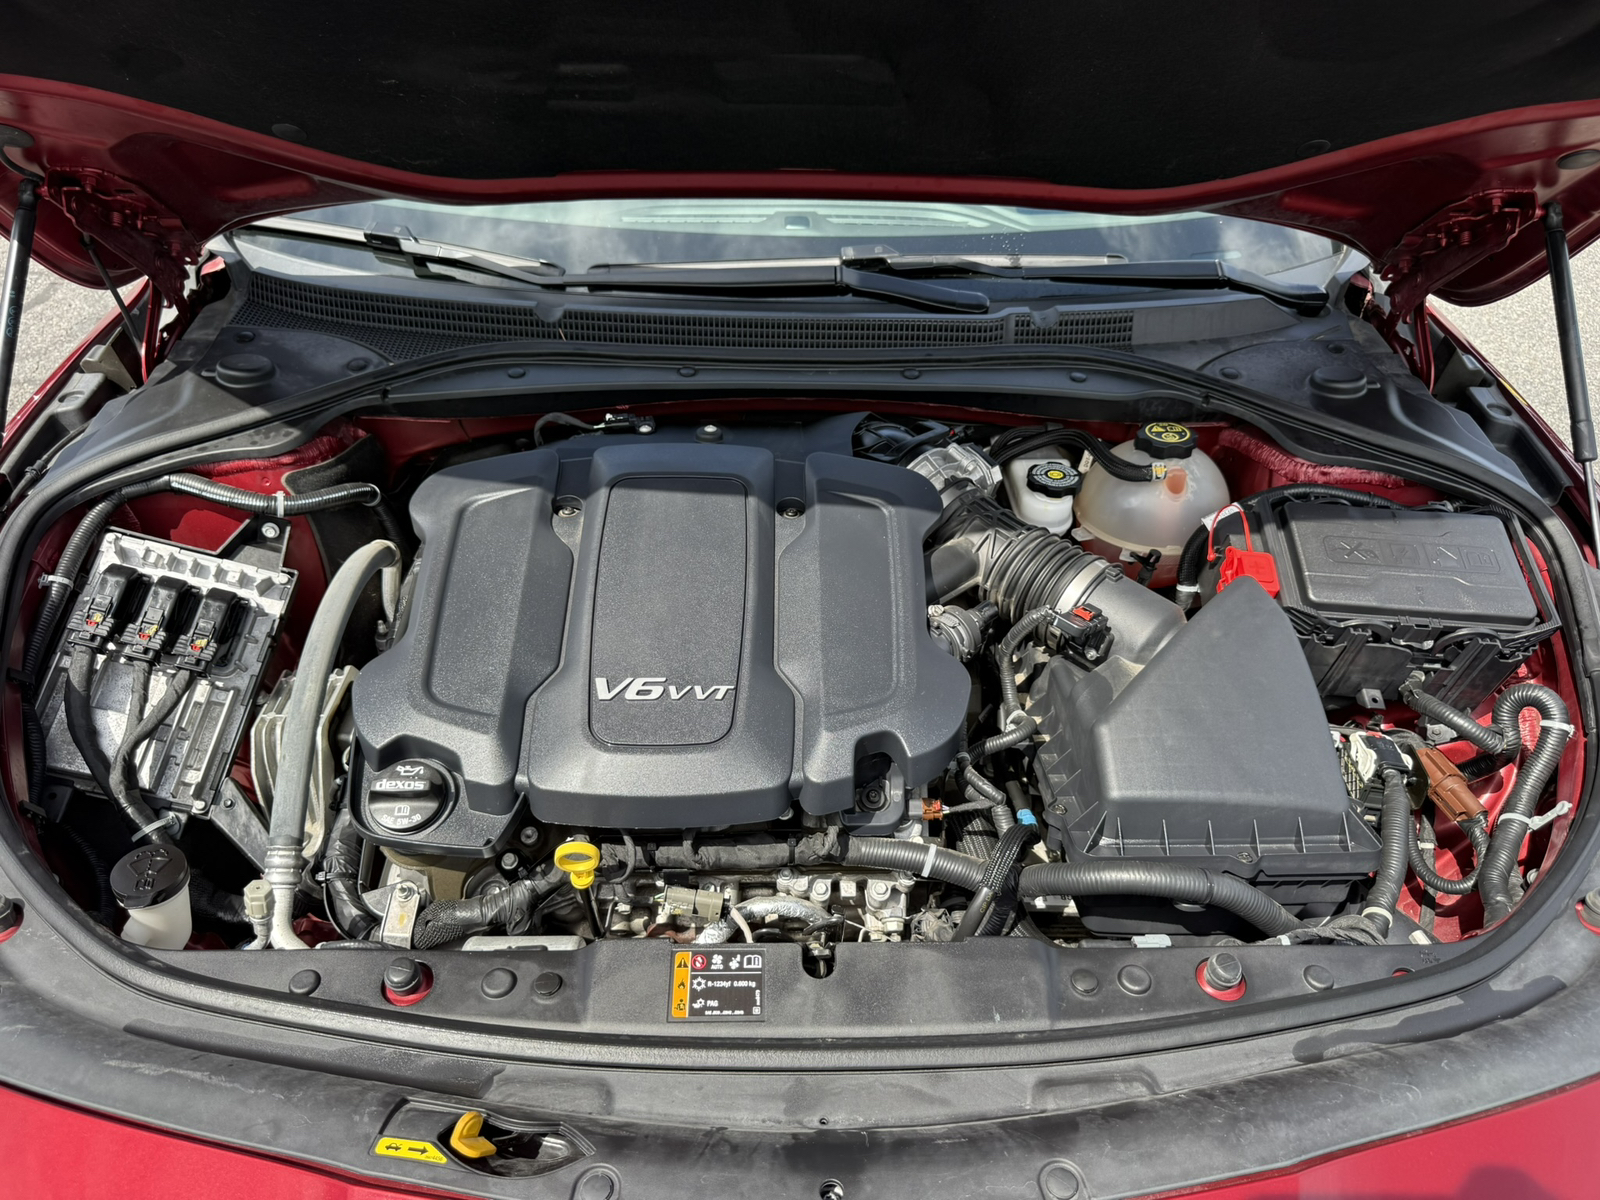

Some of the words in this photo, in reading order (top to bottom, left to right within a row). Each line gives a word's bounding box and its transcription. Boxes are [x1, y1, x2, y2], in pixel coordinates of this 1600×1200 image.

[595, 677, 667, 700] V6
[668, 685, 735, 700] VVT
[375, 779, 426, 790] dexos
[381, 814, 395, 823] SAE
[397, 813, 422, 826] 5W-30
